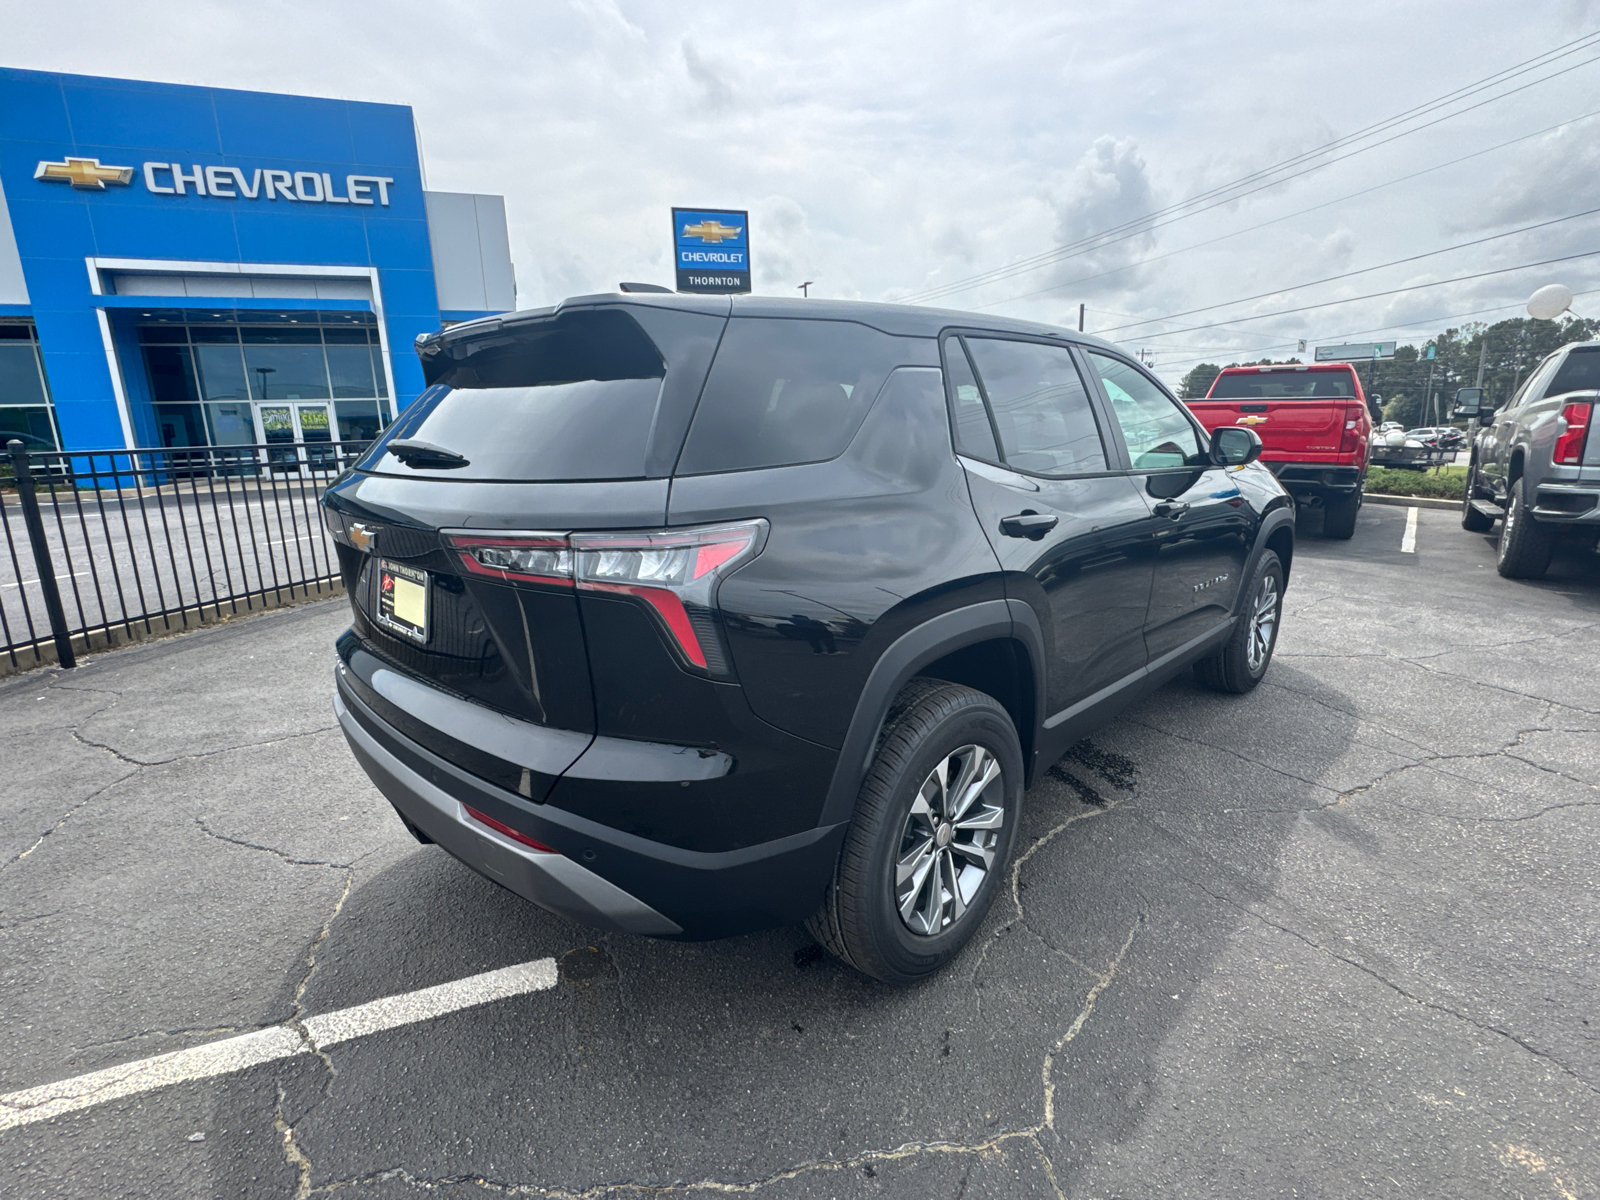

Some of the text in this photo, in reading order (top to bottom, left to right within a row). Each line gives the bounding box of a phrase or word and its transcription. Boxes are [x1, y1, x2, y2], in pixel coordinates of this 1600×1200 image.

[143, 161, 394, 206] CHEVROLET
[681, 251, 744, 263] CHEVROLET
[688, 276, 741, 286] THORNTON
[302, 414, 328, 425] SALES
[387, 561, 399, 573] JOHN
